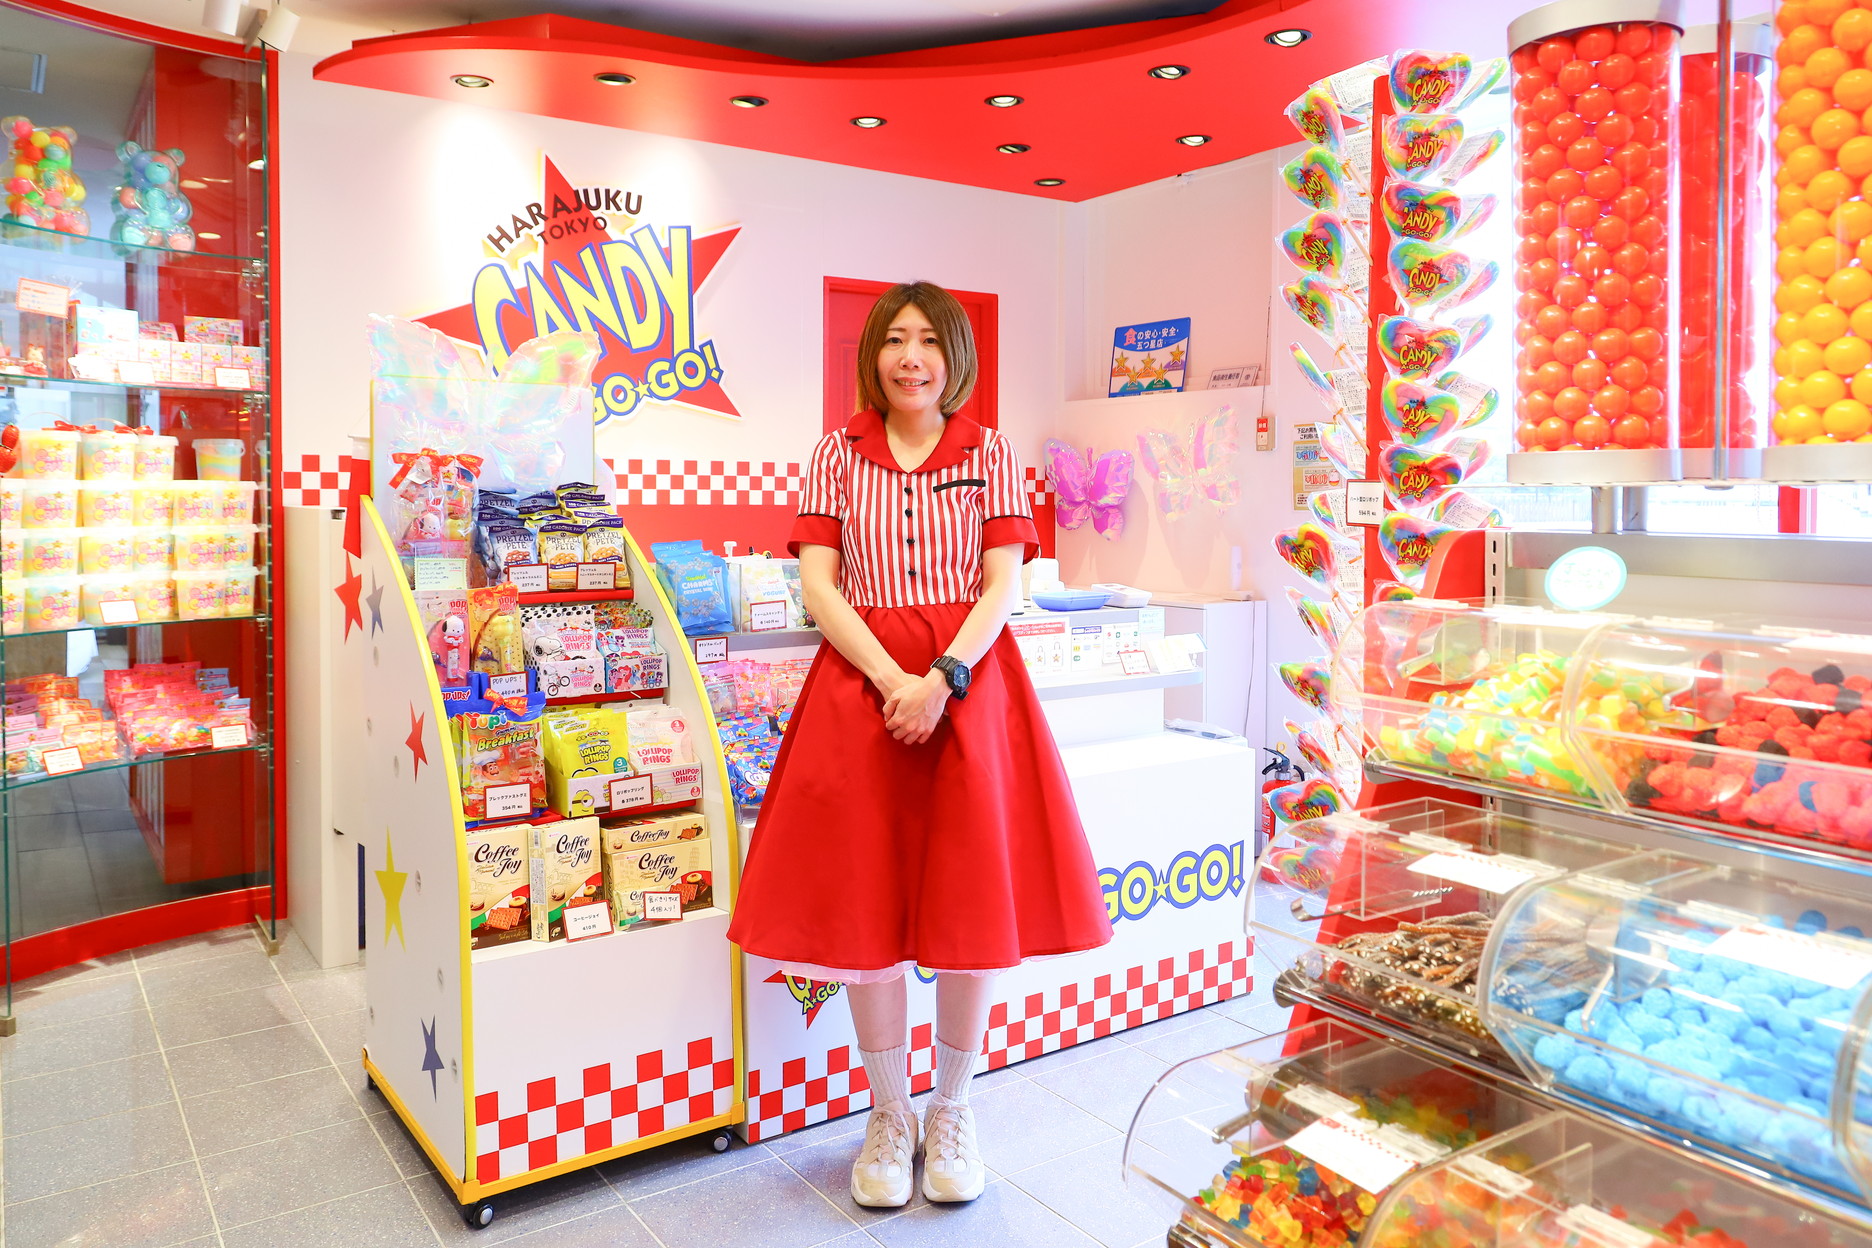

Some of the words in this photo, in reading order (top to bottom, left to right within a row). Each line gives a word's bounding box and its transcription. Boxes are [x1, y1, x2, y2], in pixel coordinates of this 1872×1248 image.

[1412, 79, 1450, 101] CANDY
[487, 188, 642, 253] HARAJUKU
[537, 216, 608, 245] TOKYO
[471, 223, 693, 376] CANDY
[496, 534, 534, 544] PRETZEL
[546, 535, 581, 544] PRETZEL
[586, 531, 622, 540] PRETZEL
[596, 537, 616, 545] PETE
[506, 542, 527, 550] PETE
[555, 543, 575, 551] PETE
[560, 634, 592, 643] LOLLIPOP
[565, 642, 590, 651] RINGS
[641, 658, 662, 666] LOLLIPOP
[464, 711, 508, 730] Yupi
[477, 727, 535, 752] Breakfast
[580, 744, 610, 757] LOLLIPOP
[637, 747, 673, 757] LOLLIPOP
[584, 752, 610, 765] RINGS
[616, 758, 623, 767] 3
[642, 755, 672, 765] RINGS
[673, 768, 700, 778] LOLLIPOP
[675, 774, 698, 784] RINGS
[630, 830, 655, 843] Coffee
[653, 829, 670, 842] Joy
[556, 834, 590, 855] Coffee
[474, 843, 520, 864] Coffee
[570, 848, 593, 868] Joy
[493, 857, 523, 878] Joy
[638, 852, 676, 871] Coffee
[654, 864, 679, 883] Joy
